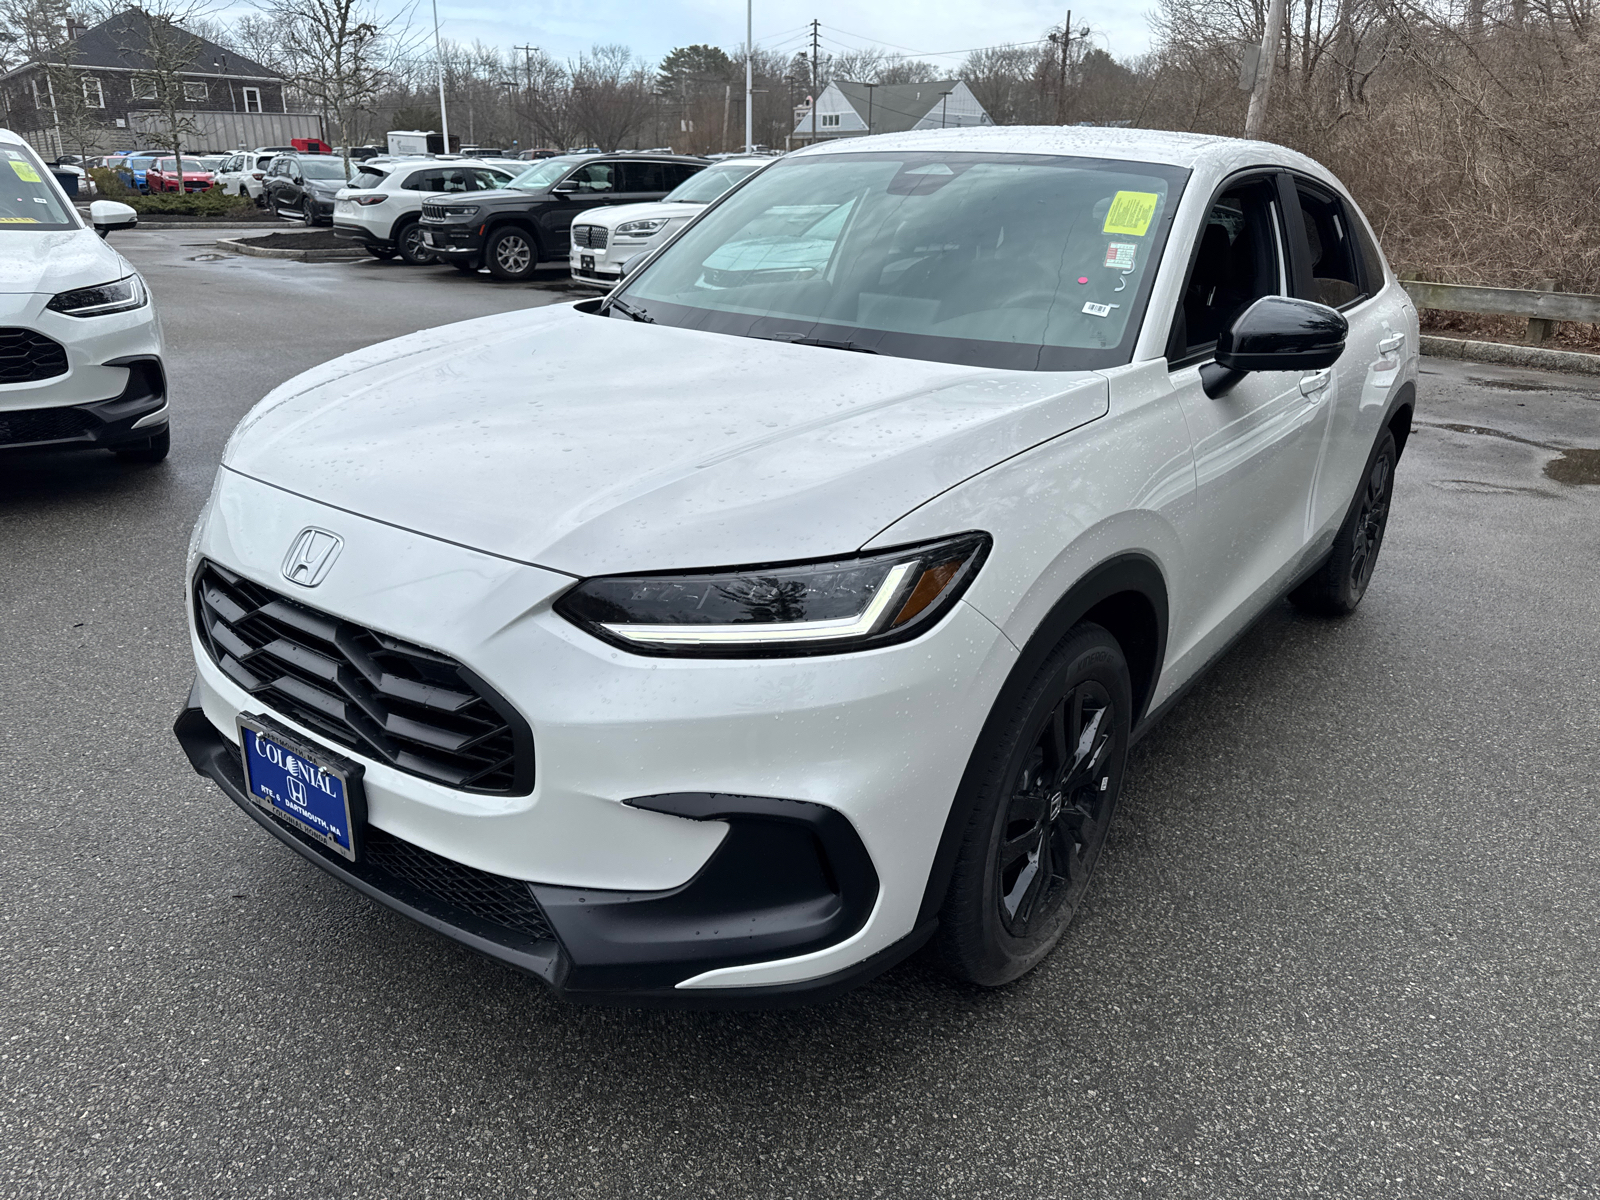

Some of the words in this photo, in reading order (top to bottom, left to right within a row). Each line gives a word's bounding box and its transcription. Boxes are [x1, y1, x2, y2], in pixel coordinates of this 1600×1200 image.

[255, 737, 337, 798] COLONIAL
[304, 825, 328, 845] HONDA
[329, 823, 341, 837] MA
